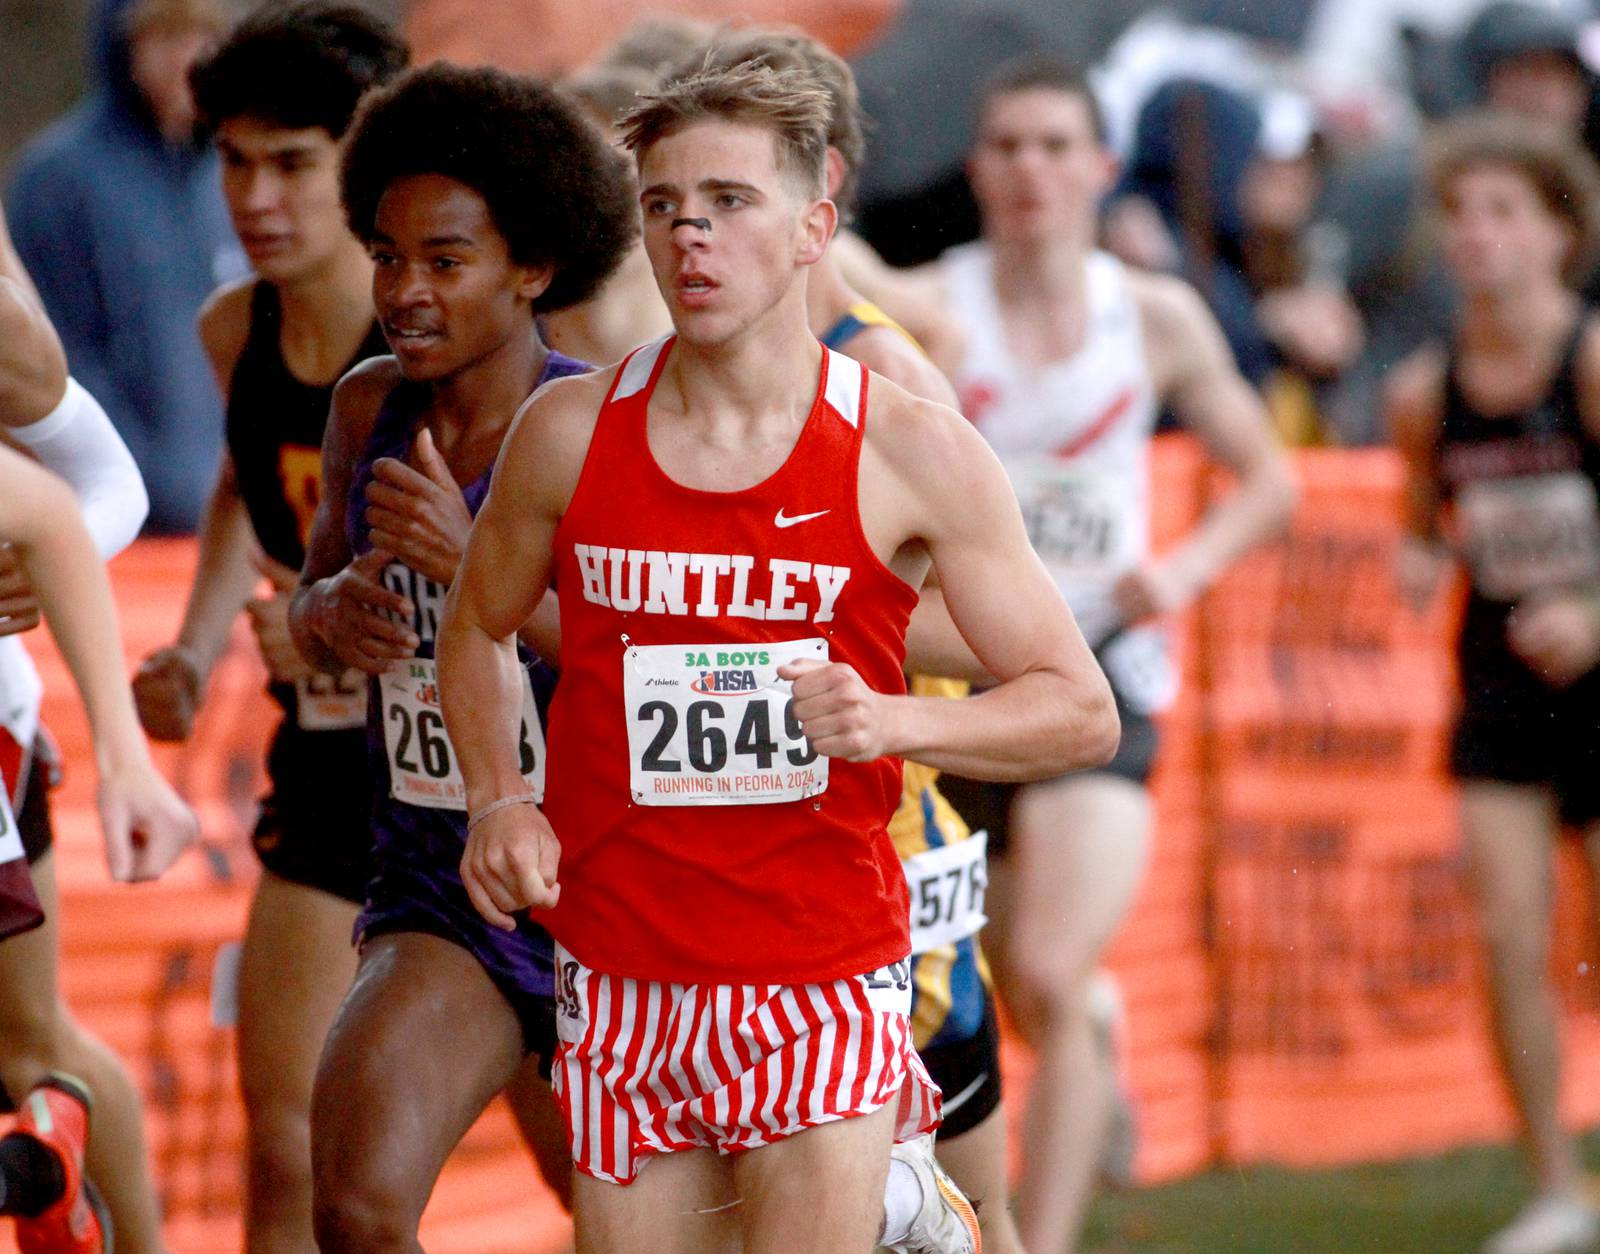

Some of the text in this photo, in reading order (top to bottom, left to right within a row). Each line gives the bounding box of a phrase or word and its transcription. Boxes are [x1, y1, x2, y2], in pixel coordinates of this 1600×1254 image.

[574, 543, 850, 623] HUNTLEY
[685, 651, 770, 667] 3A BOYS
[654, 768, 815, 793] RUNNING IN PEORIA 2024
